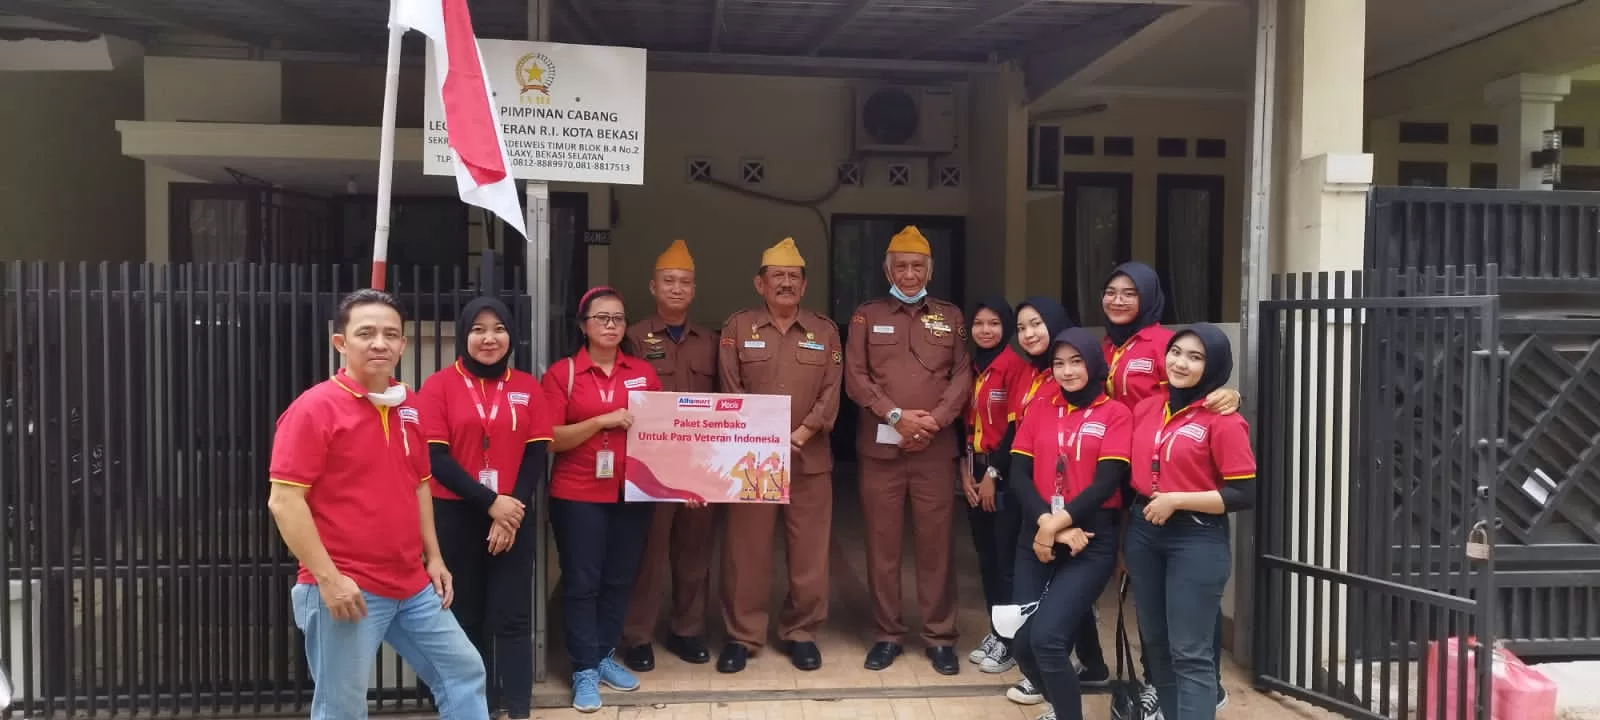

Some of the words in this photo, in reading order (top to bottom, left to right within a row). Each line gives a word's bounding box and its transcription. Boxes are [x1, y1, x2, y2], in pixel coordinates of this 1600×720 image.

[501, 106, 563, 119] PIMPINAN
[567, 110, 618, 122] CABANG
[500, 123, 536, 135] ERAN
[562, 127, 593, 138] KOTA
[597, 128, 638, 141] BEKASI
[548, 141, 576, 151] TIMUR
[579, 143, 601, 152] BLOK
[536, 150, 566, 160] BEKASI
[568, 152, 604, 161] SELATAN
[674, 418, 700, 428] Paket
[703, 419, 746, 429] Sembako
[638, 432, 667, 441] Untuk
[670, 432, 692, 442] Para
[694, 433, 732, 443] Veteran
[734, 435, 780, 444] Indonesia
